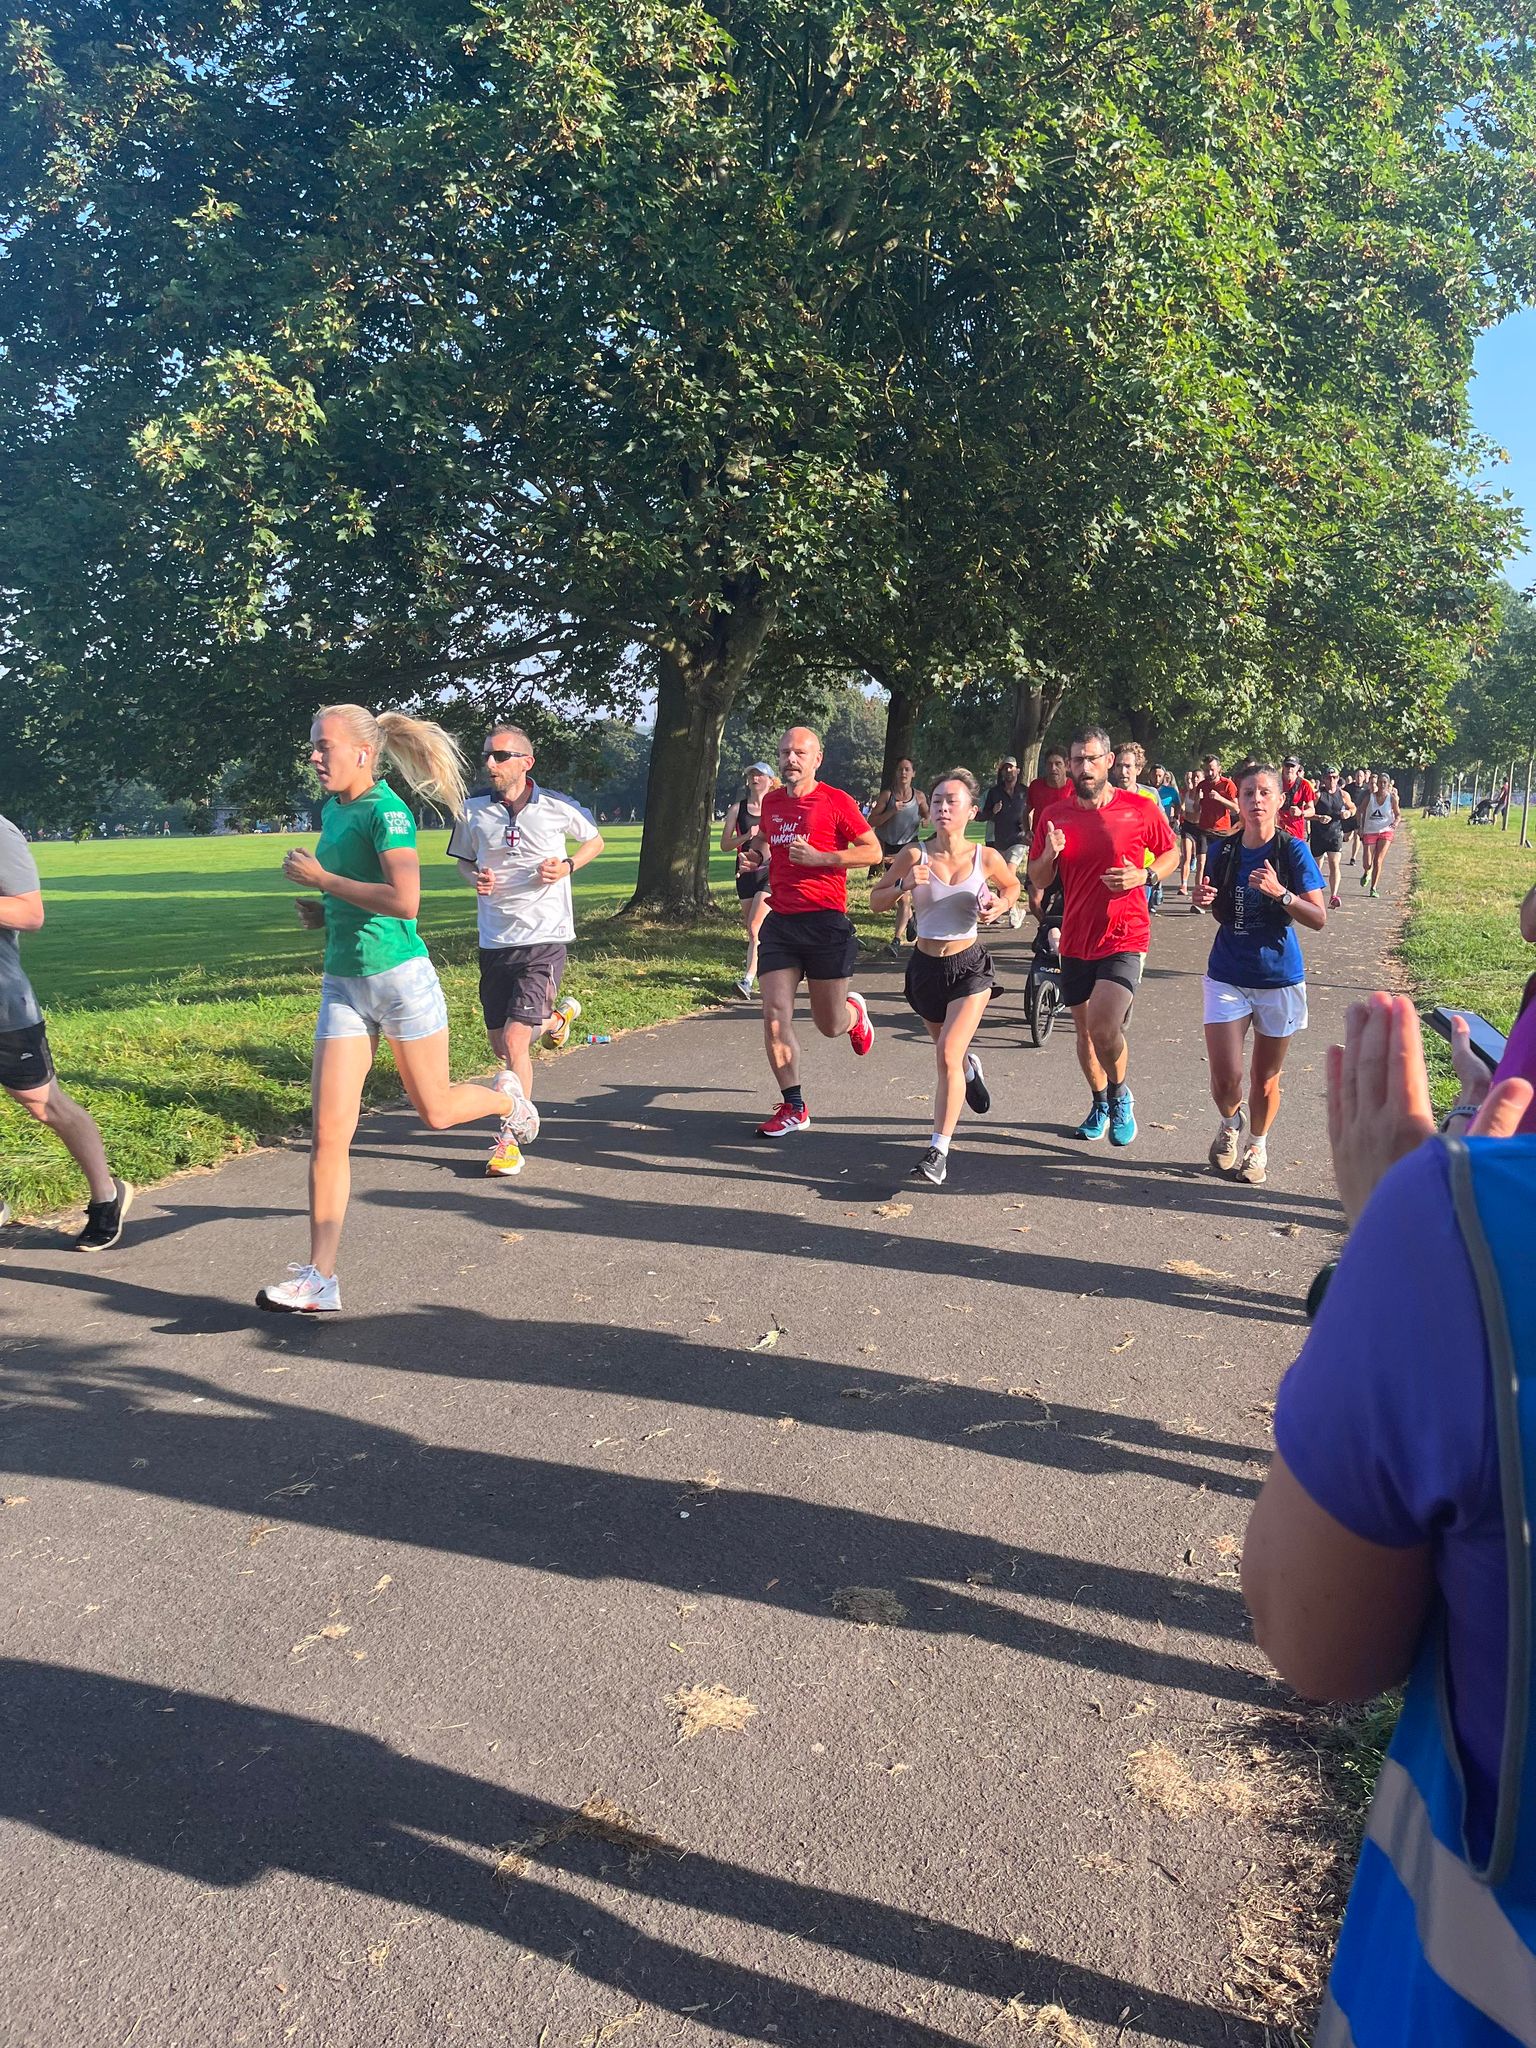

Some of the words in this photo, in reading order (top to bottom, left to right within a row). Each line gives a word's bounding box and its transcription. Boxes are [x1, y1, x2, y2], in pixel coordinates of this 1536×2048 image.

[384, 811, 407, 819] FIND
[779, 822, 798, 834] HALF
[771, 833, 810, 844] MARATHN
[1235, 886, 1244, 929] FINISHER
